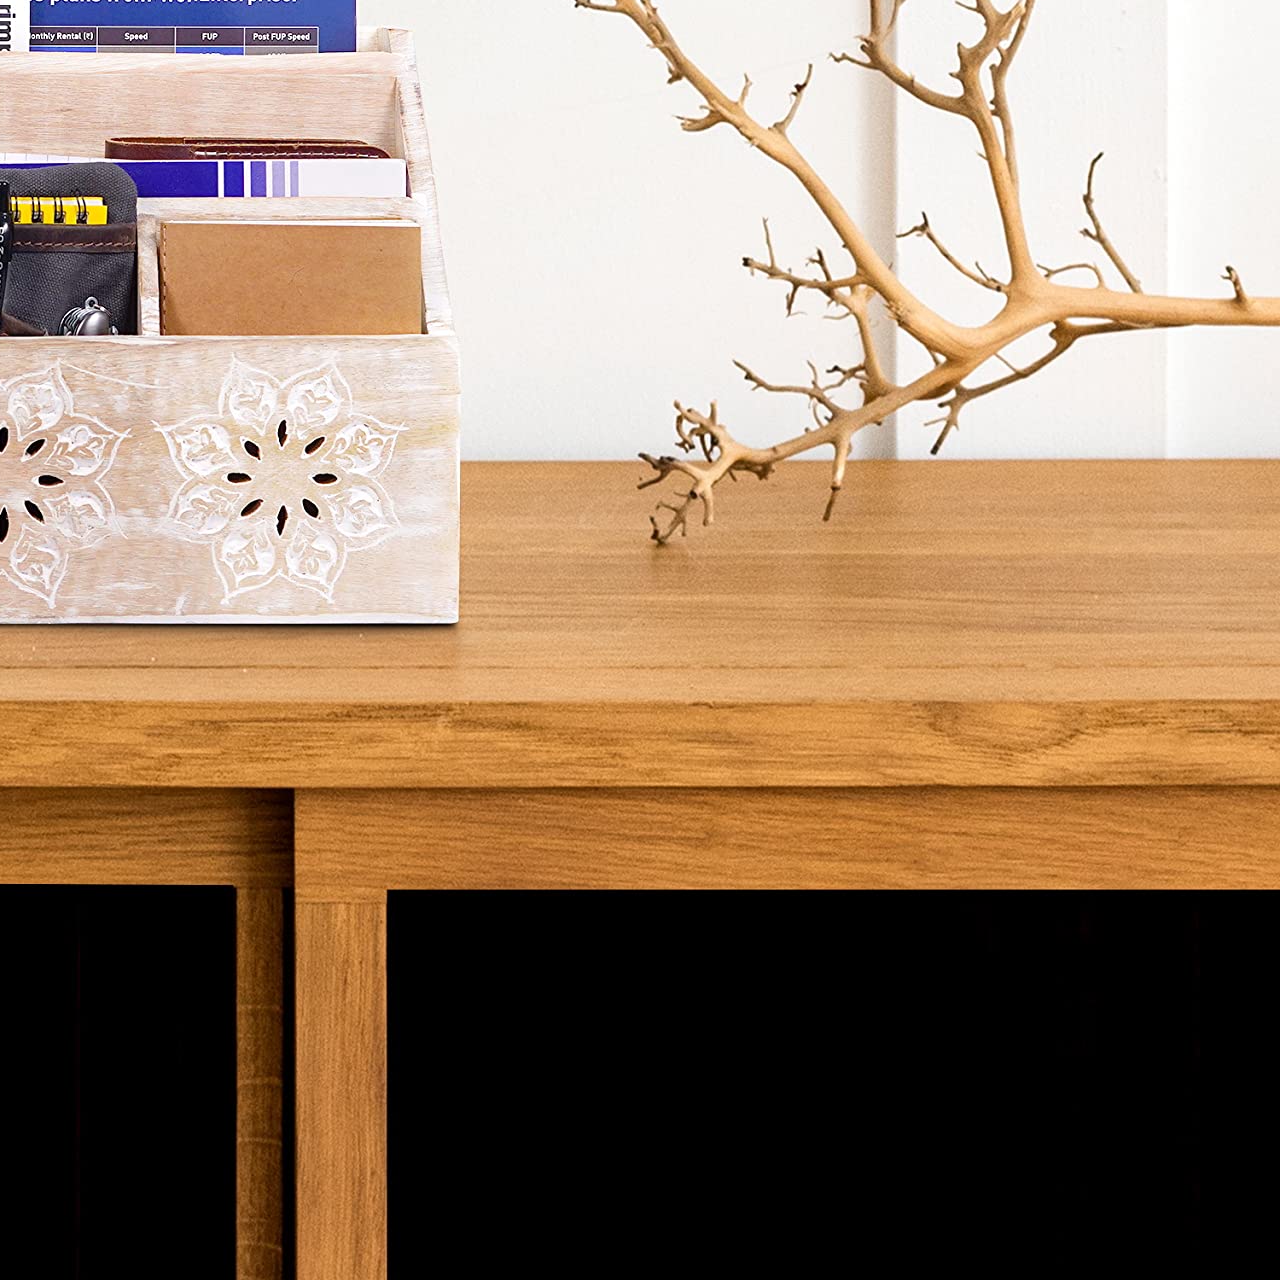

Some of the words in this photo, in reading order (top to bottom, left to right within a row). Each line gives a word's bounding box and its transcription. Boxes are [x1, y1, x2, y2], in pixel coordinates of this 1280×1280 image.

[30, 32, 55, 42] onthly
[56, 32, 82, 40] Rental
[124, 32, 149, 42] Speed
[201, 32, 219, 40] FUP
[252, 32, 270, 41] Post
[270, 32, 287, 41] FUP
[287, 32, 311, 42] Speed
